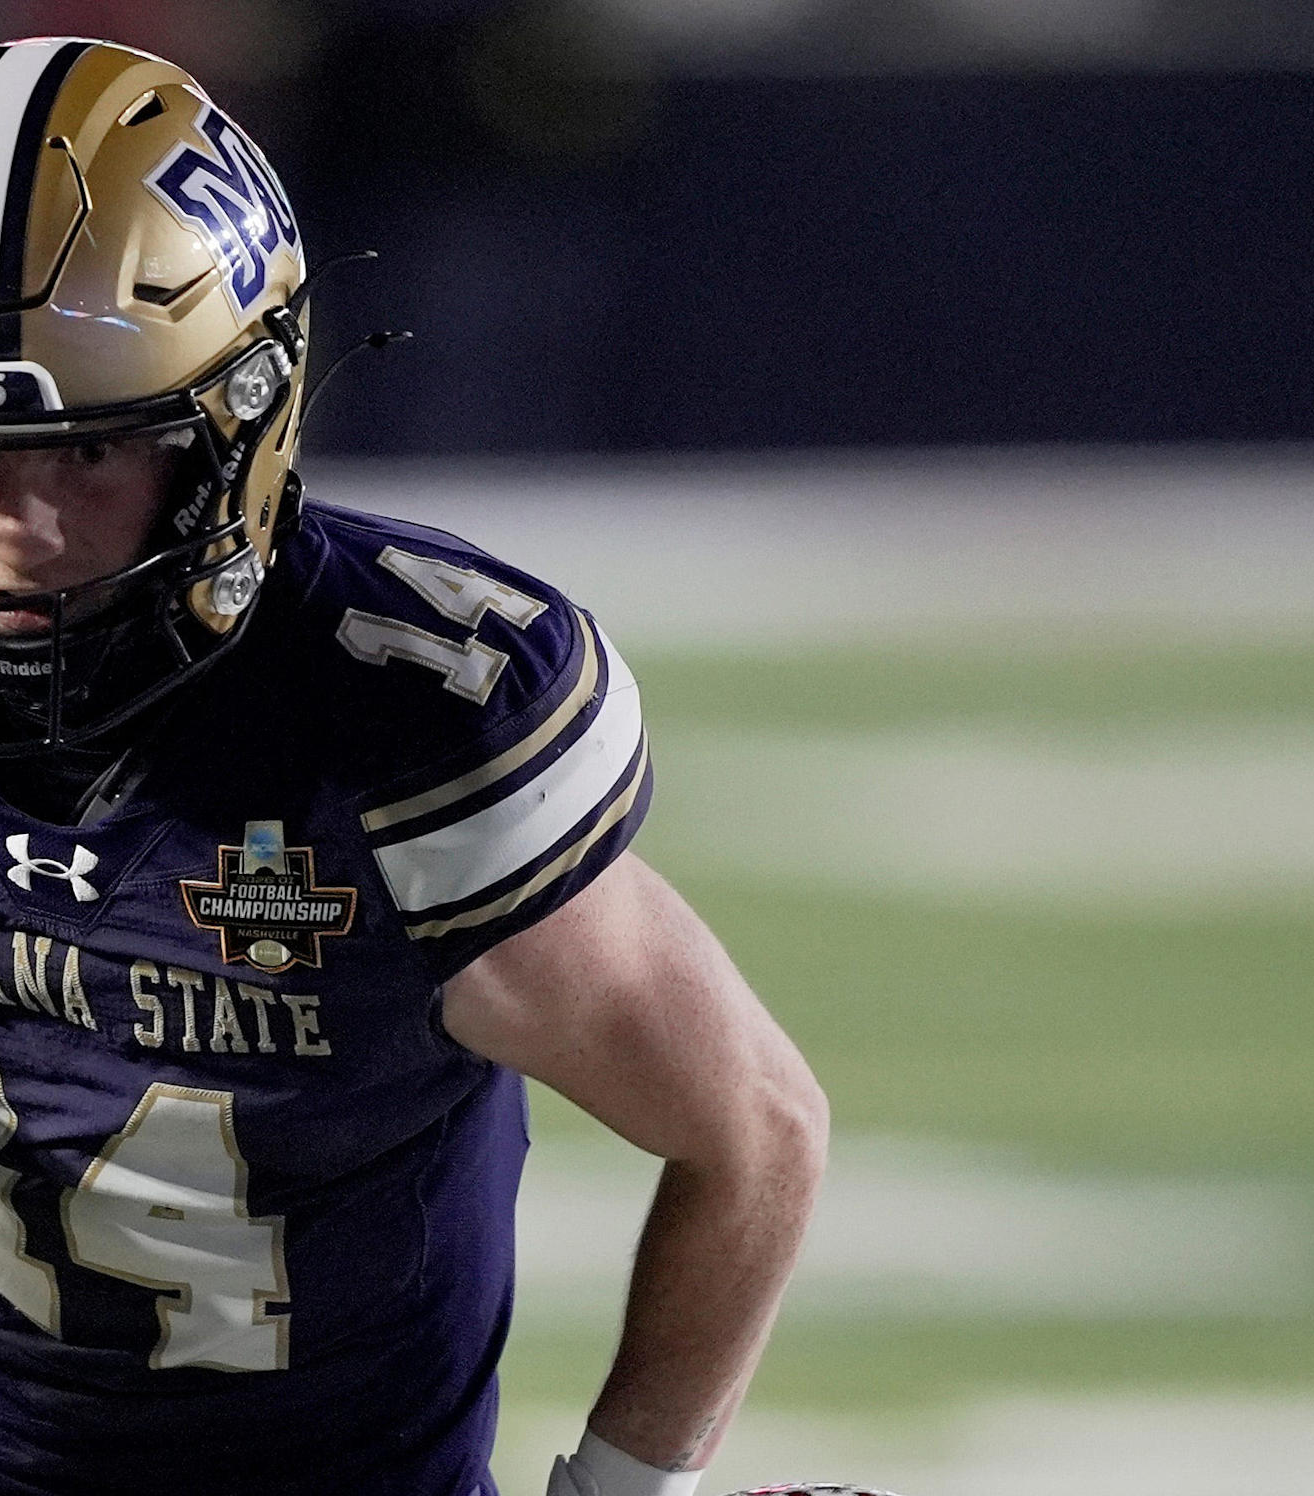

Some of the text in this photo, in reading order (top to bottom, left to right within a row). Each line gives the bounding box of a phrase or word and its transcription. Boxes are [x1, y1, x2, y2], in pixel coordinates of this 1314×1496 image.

[173, 441, 246, 536] Ridell
[336, 545, 549, 706] 14
[199, 897, 342, 922] CHAMPIONSHIP
[229, 883, 303, 901] FOOTBALL
[238, 928, 299, 940] NASHVILLE
[130, 960, 331, 1057] STATE
